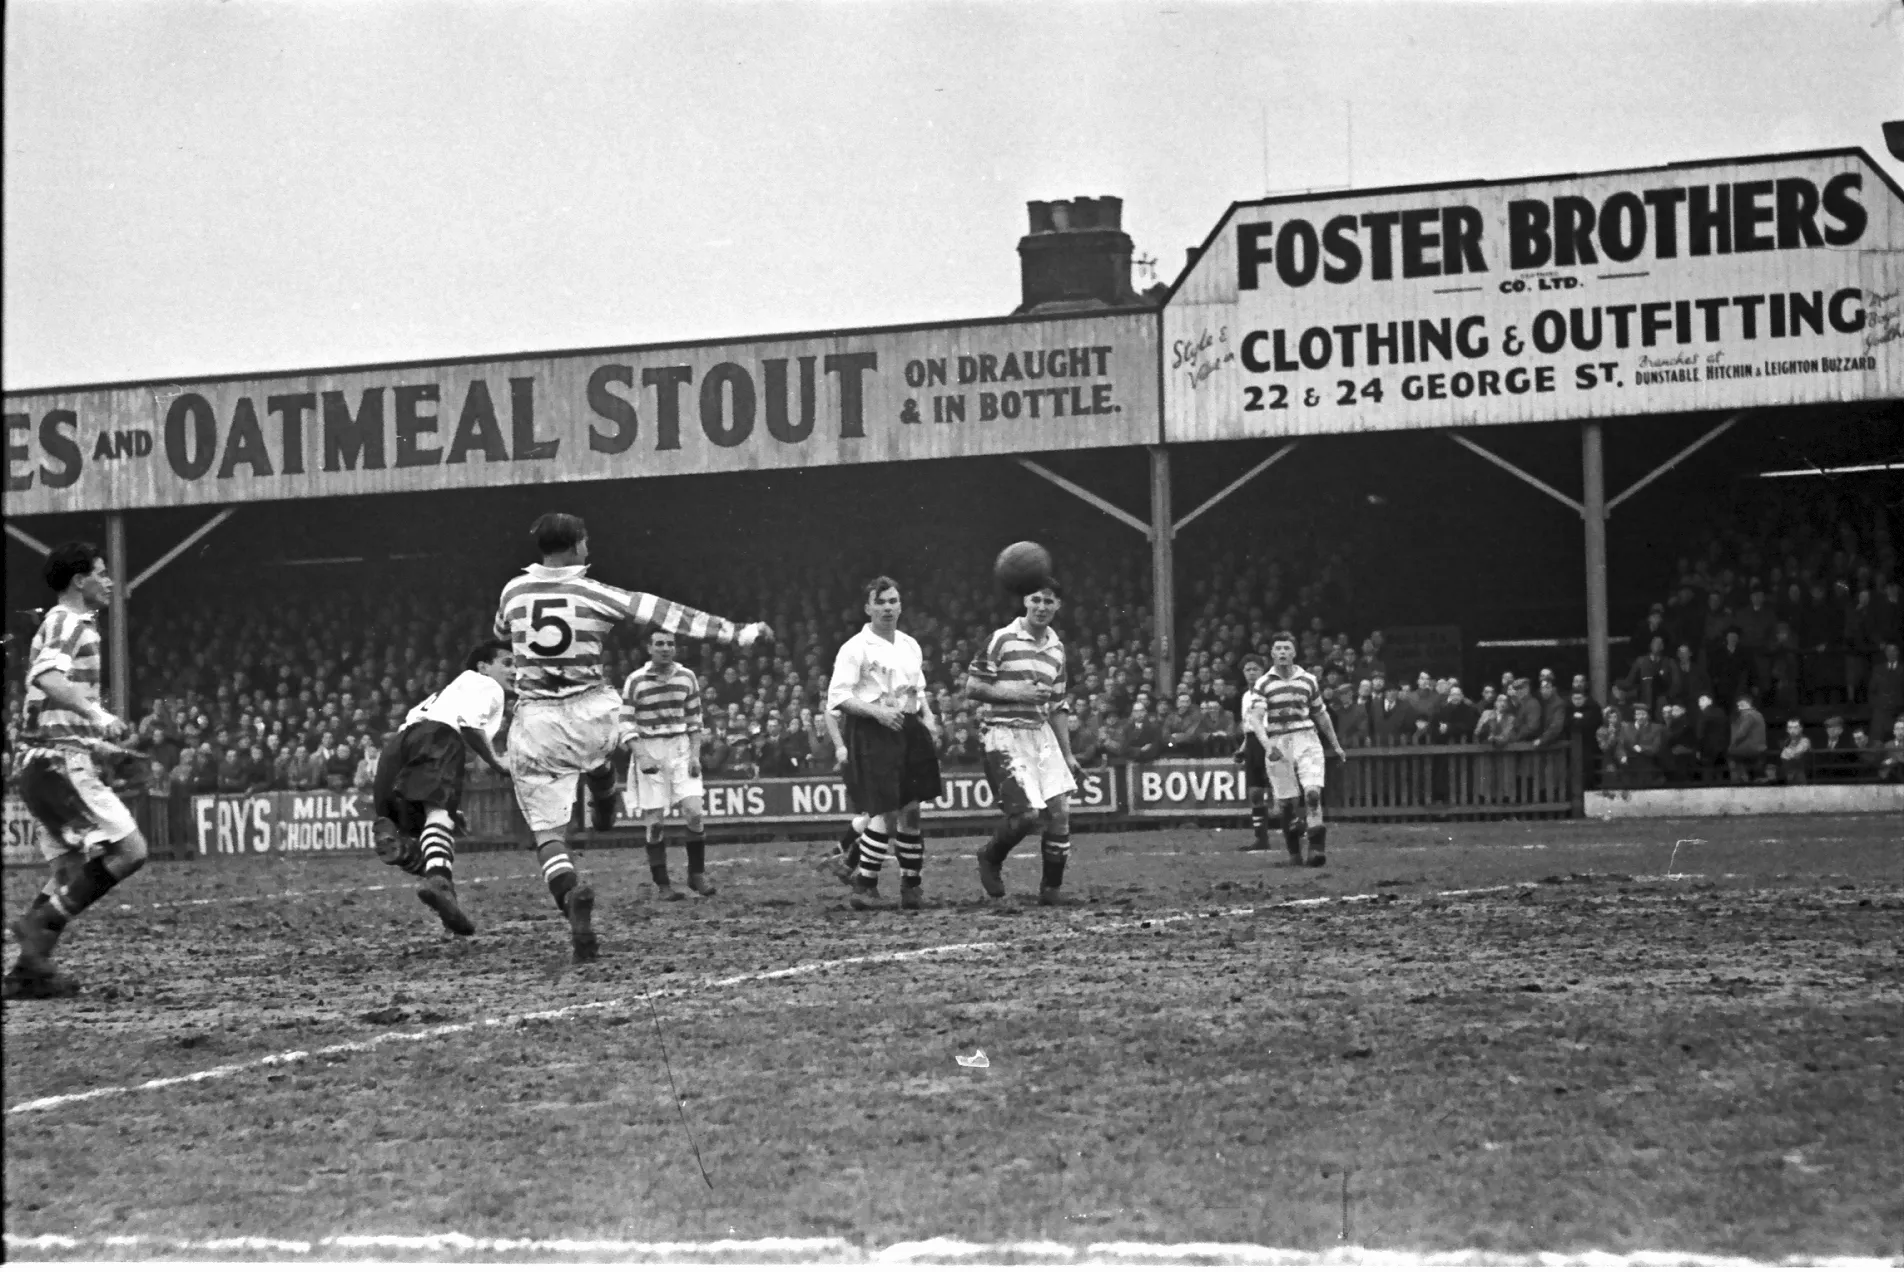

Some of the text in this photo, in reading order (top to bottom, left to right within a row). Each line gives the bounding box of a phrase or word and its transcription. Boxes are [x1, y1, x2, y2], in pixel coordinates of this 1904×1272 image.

[1237, 172, 1868, 291] FOSTER BROTHERS
[1499, 276, 1584, 294] CO. LTD.
[1240, 315, 1489, 373] CLOTHING
[1502, 325, 1525, 357] &
[1532, 287, 1866, 354] OUTFITTING
[905, 346, 1113, 388] ON DRAUGHT
[1243, 362, 1624, 411] 22 & 24 GEORGE ST.
[1635, 367, 1699, 386] DUNSTABLE
[1706, 364, 1753, 381] HITCHIN
[1764, 359, 1819, 376] LEIGHTON
[1821, 355, 1877, 373] BUZZARD
[92, 429, 153, 461] AND
[164, 376, 560, 481] OATMEAL
[586, 352, 878, 454] STOUT
[900, 384, 1122, 424] & IN BOTTLE.
[528, 598, 573, 657] 5
[1142, 770, 1247, 802] BOVRI
[293, 795, 359, 820] MILK
